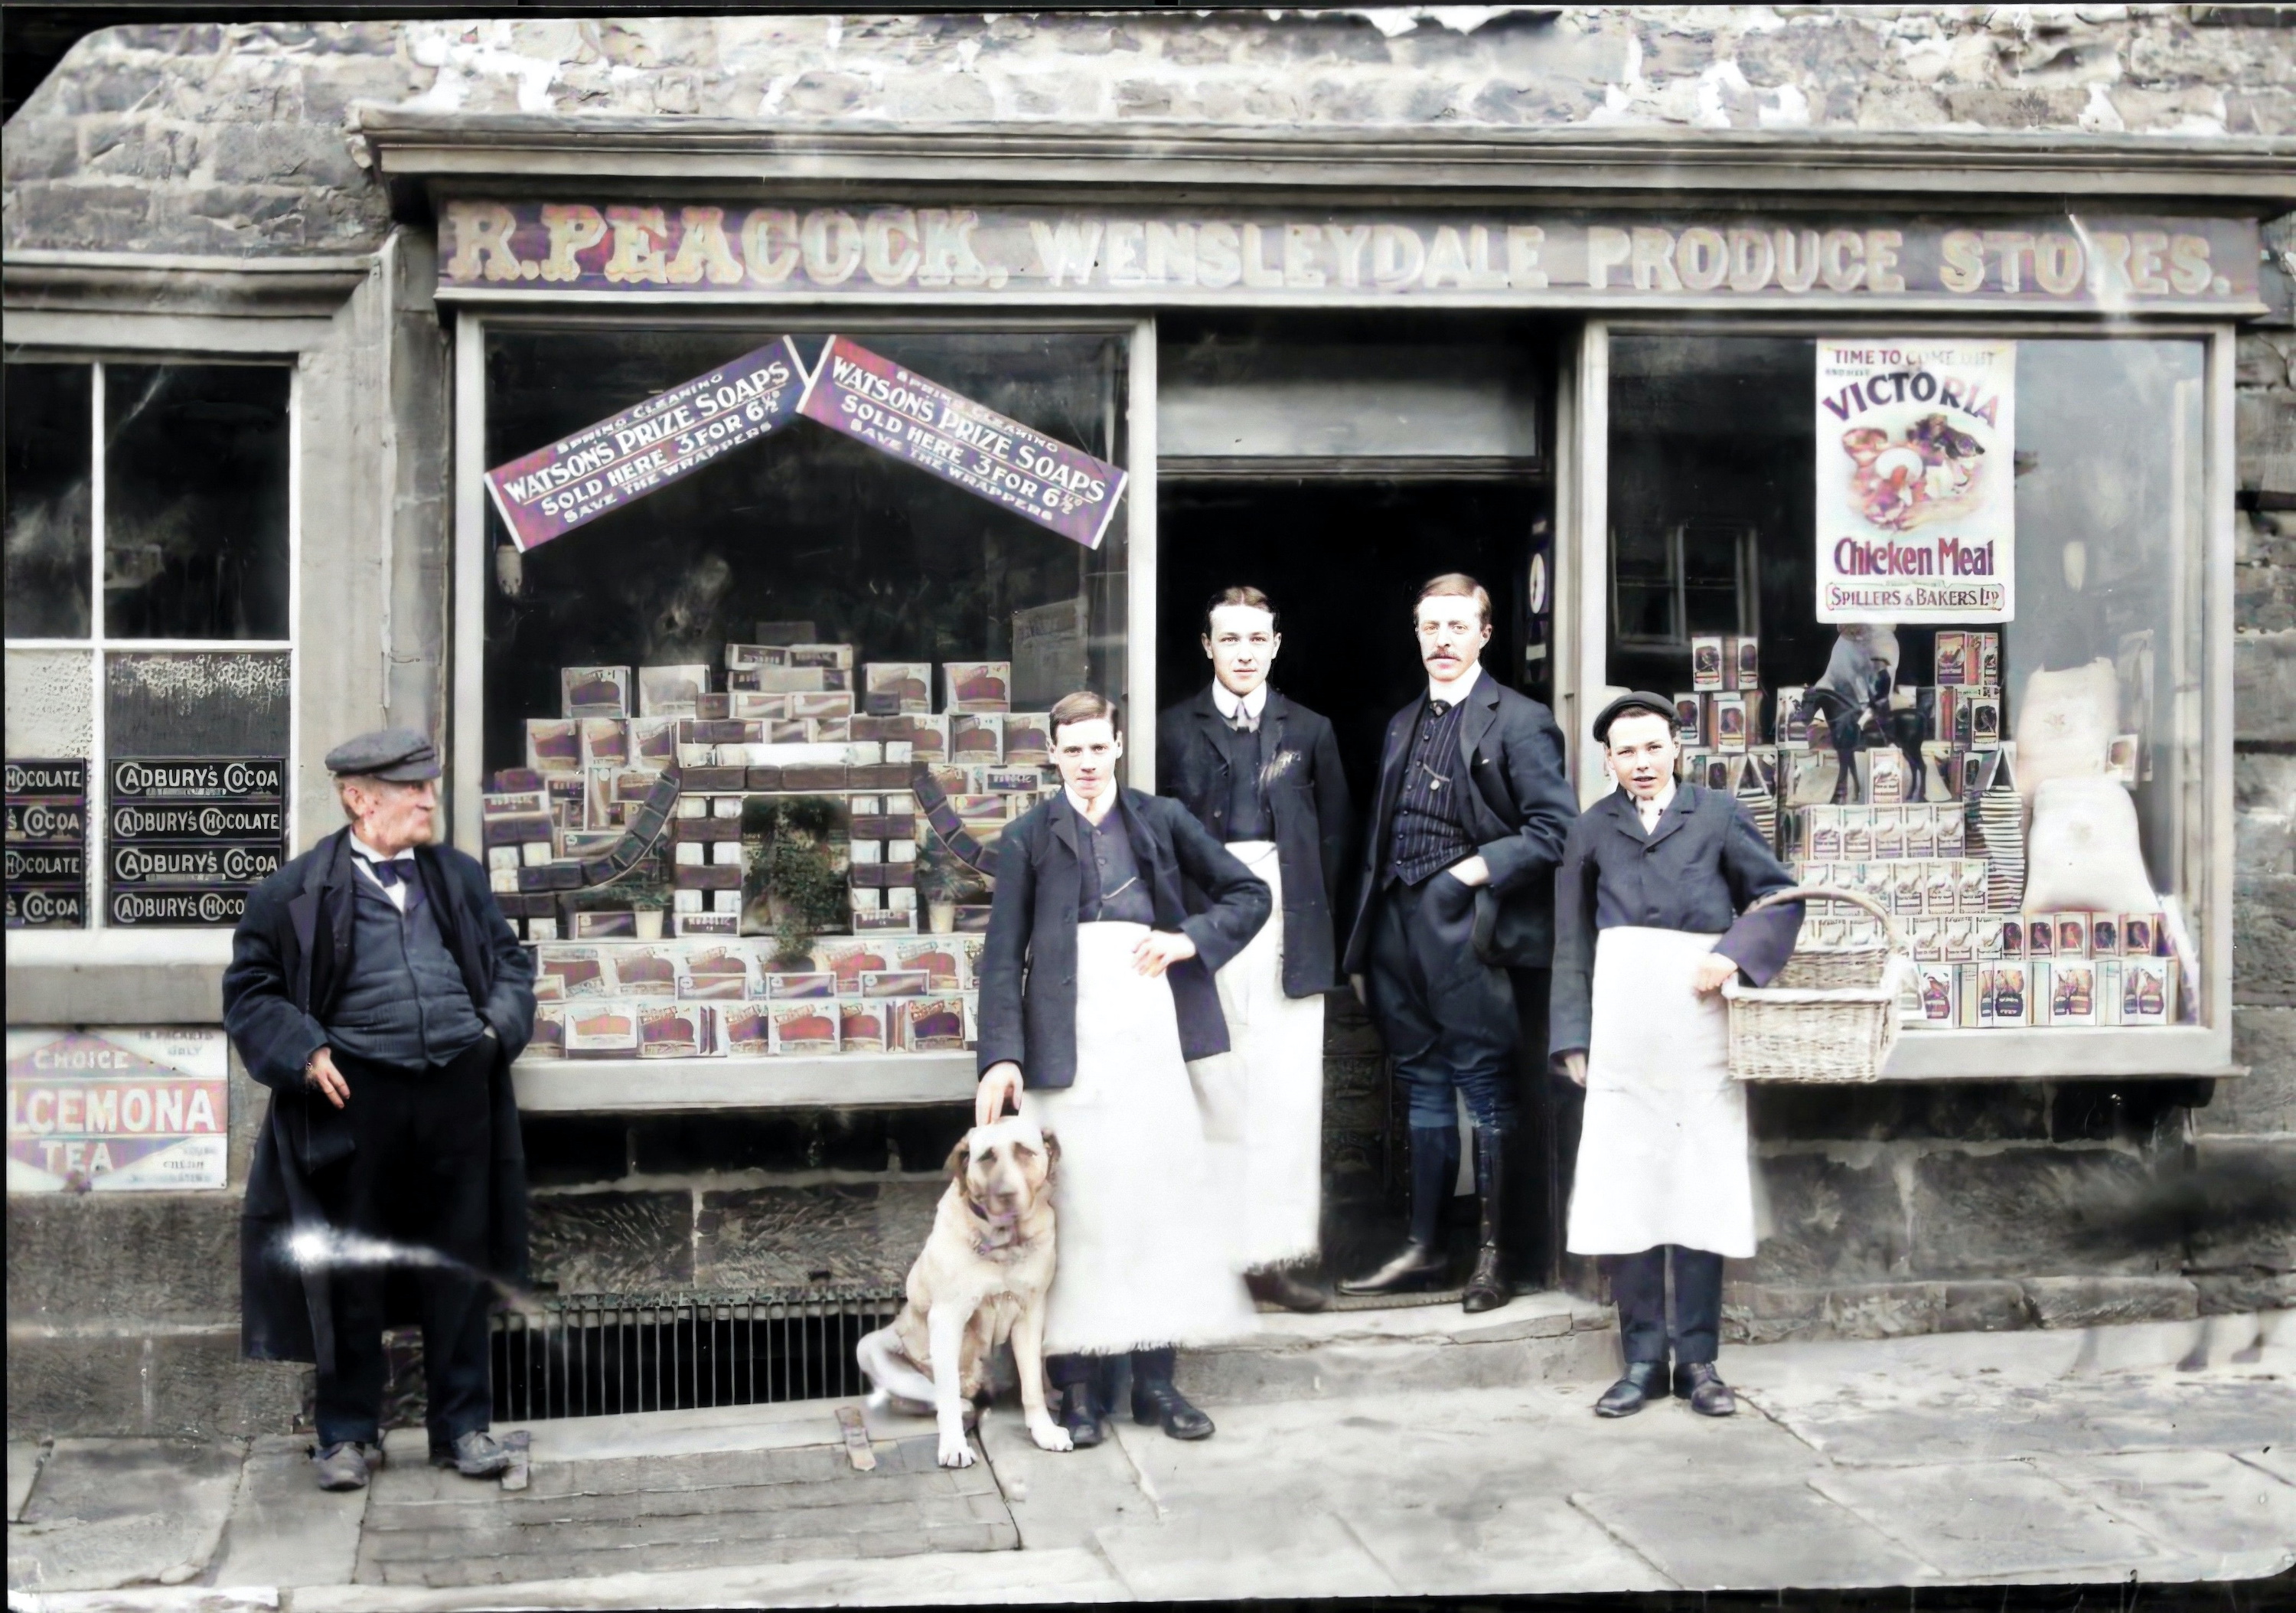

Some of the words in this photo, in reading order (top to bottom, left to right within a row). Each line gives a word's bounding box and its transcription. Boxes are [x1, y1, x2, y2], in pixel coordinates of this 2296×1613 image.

[1029, 220, 1548, 289] WENSLEYDALE
[1587, 227, 1906, 292] PRODUCE
[1834, 349, 1874, 364] TIME
[1878, 349, 1902, 364] TO
[615, 405, 695, 455] PRIZE
[694, 361, 790, 417] SOAPS
[1821, 371, 1999, 429] VICTORIA
[841, 393, 902, 433] SOLD
[906, 426, 964, 465] HERE
[850, 417, 902, 452] SAVE
[911, 446, 942, 471] THE
[948, 468, 1052, 521] WRAPPERS
[938, 407, 1013, 460] PRIZE
[1016, 444, 1105, 502] SOAPS
[540, 480, 603, 516] SOLD
[611, 448, 668, 487] HERE
[564, 495, 617, 524] SAVE
[622, 473, 661, 495] THE
[664, 421, 772, 477] WRAPPERS
[1834, 537, 1933, 576] Chicken
[1937, 537, 1994, 576] Meal
[1831, 586, 1901, 606] SPILLERS
[1904, 593, 1913, 606] &
[1916, 586, 1977, 606] BAKERS
[223, 762, 279, 794] COCOA
[24, 805, 80, 837] COCOA
[199, 807, 280, 836] CHOCOLATE
[223, 847, 278, 880] COCOA
[23, 891, 80, 923] COCOA
[199, 893, 245, 922] CHOCO
[33, 1050, 130, 1070] CHOICE
[38, 1139, 114, 1174] TEA
